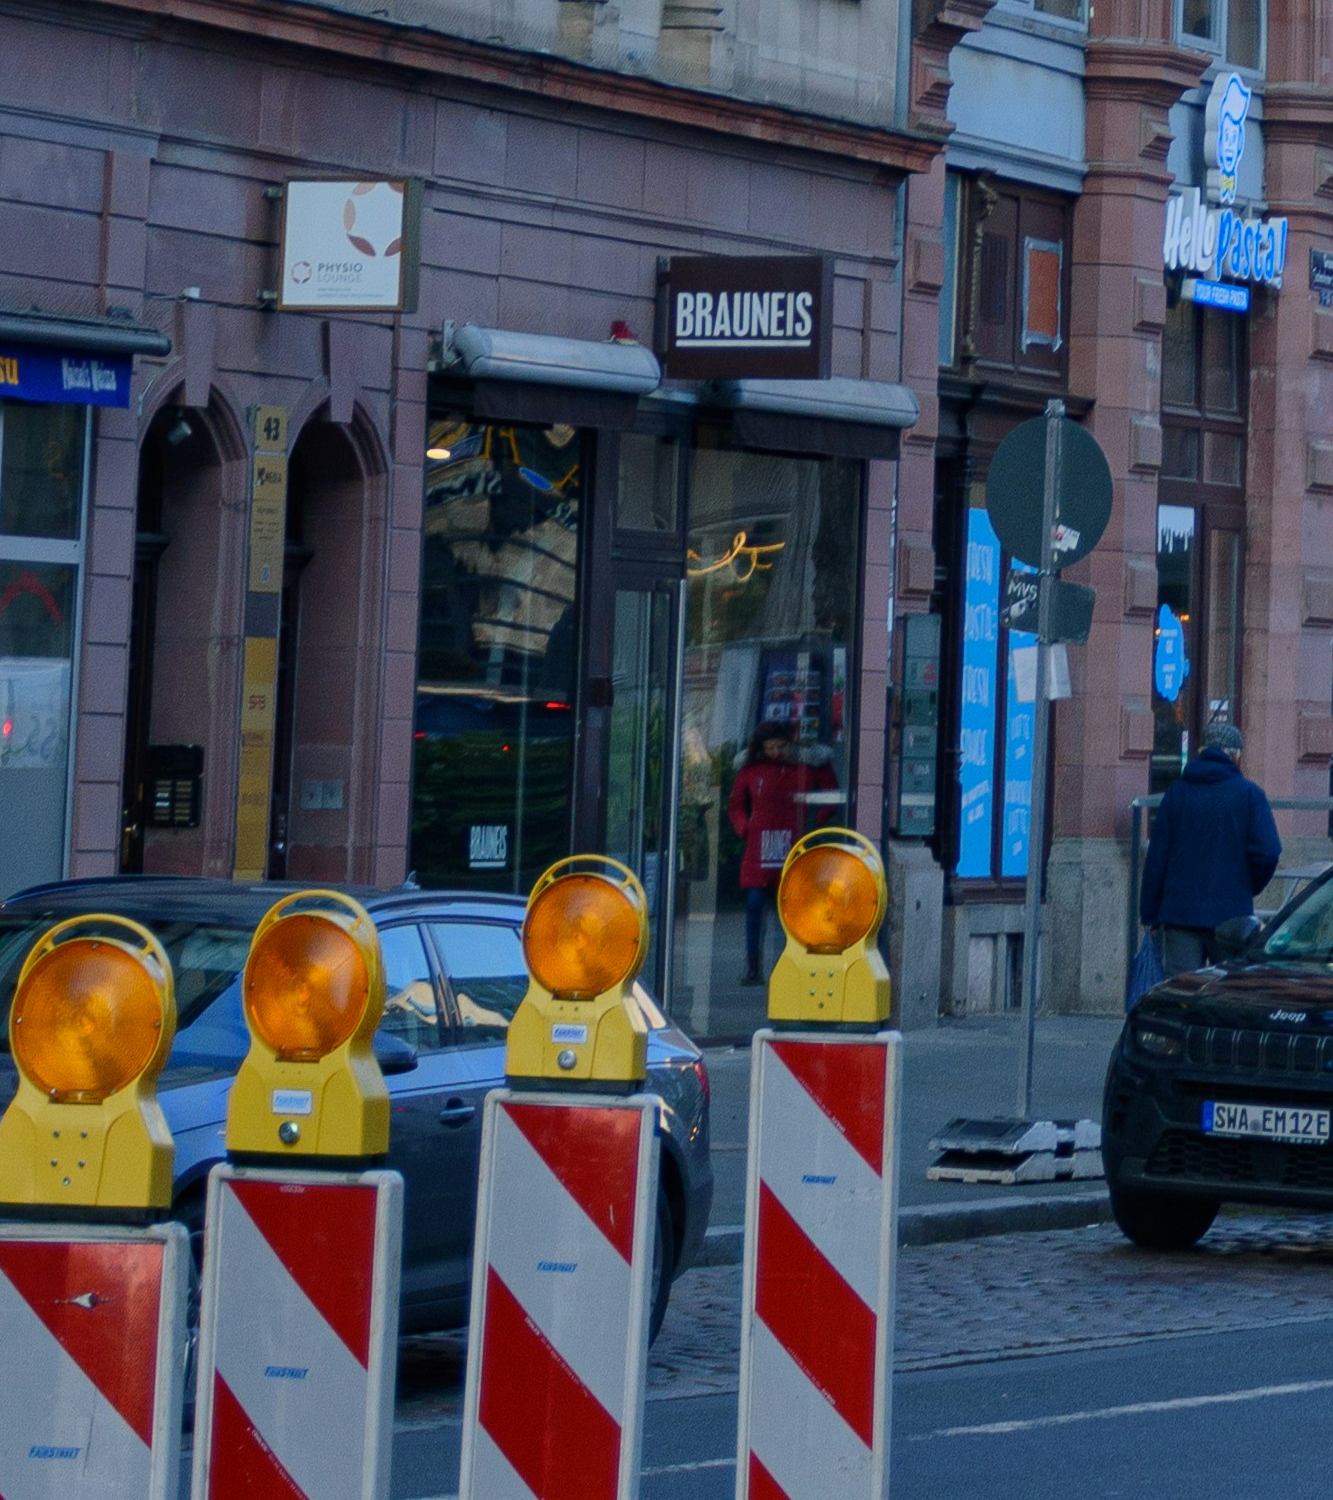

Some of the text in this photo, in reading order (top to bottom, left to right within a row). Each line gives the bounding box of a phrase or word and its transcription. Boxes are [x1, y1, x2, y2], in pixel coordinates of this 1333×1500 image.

[1163, 186, 1215, 271] Hello
[1215, 208, 1288, 290] Pasta!
[317, 262, 364, 273] PHYSIO
[317, 273, 362, 284] LOUNGE
[675, 291, 814, 338] BRAUNEIS
[263, 416, 281, 442] 43
[1269, 1008, 1307, 1024] Jeep
[1214, 1105, 1249, 1132] SWA
